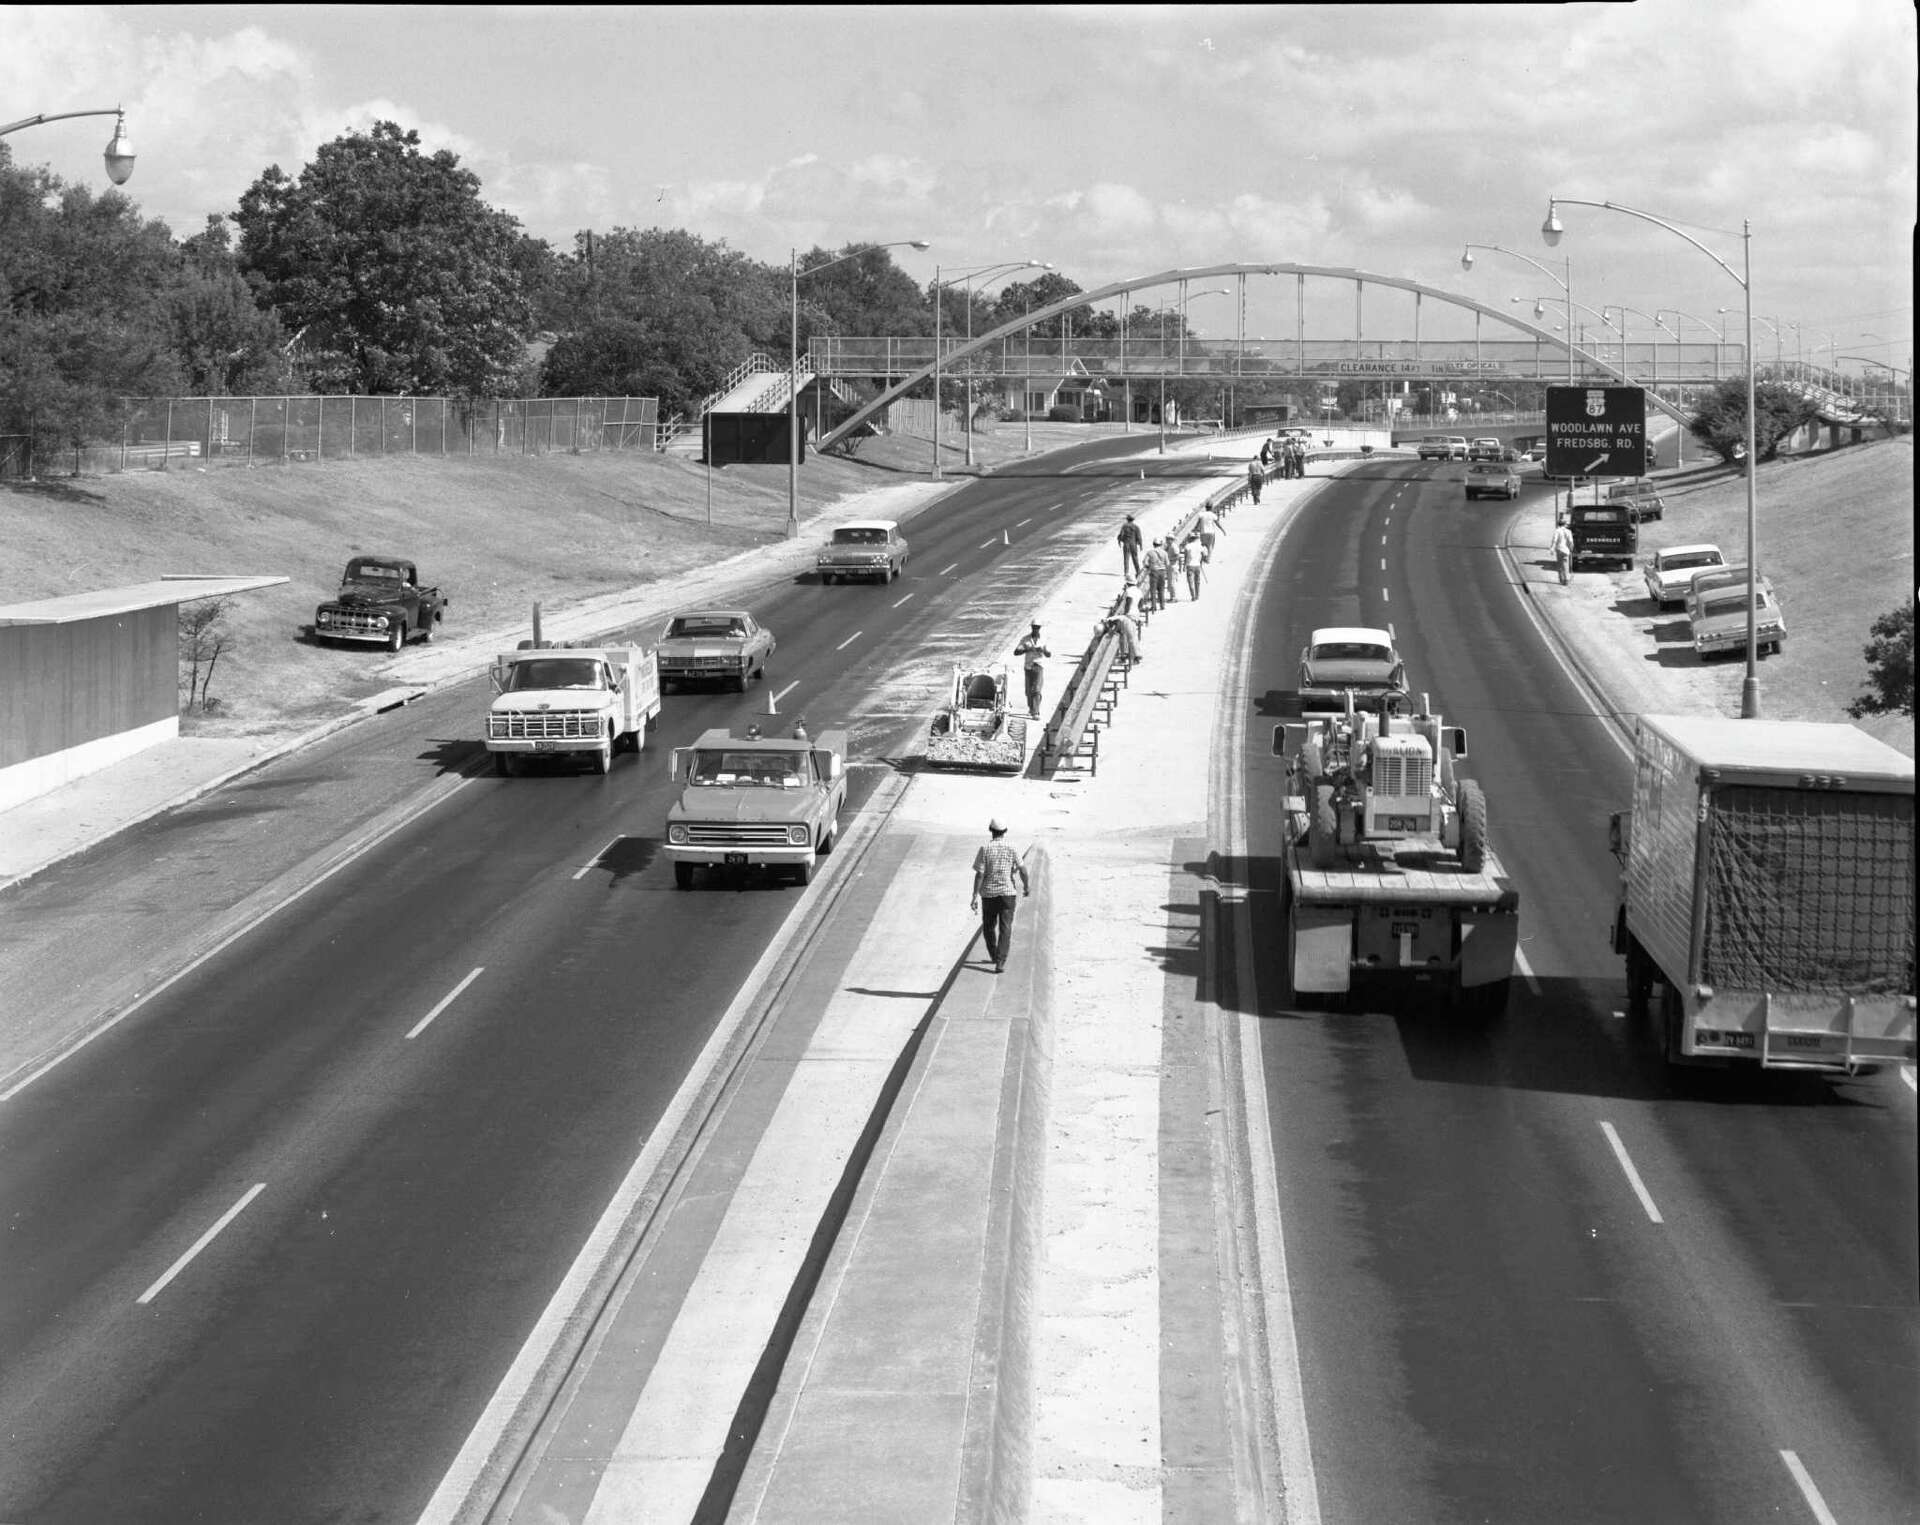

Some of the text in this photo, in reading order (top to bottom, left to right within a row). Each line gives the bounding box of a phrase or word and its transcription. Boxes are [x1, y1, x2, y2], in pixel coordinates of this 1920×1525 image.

[1341, 363, 1397, 373] CLEARANCE
[1551, 423, 1641, 433] WOODLAWN AVE
[1556, 438, 1635, 448] FREDSBG. RD.
